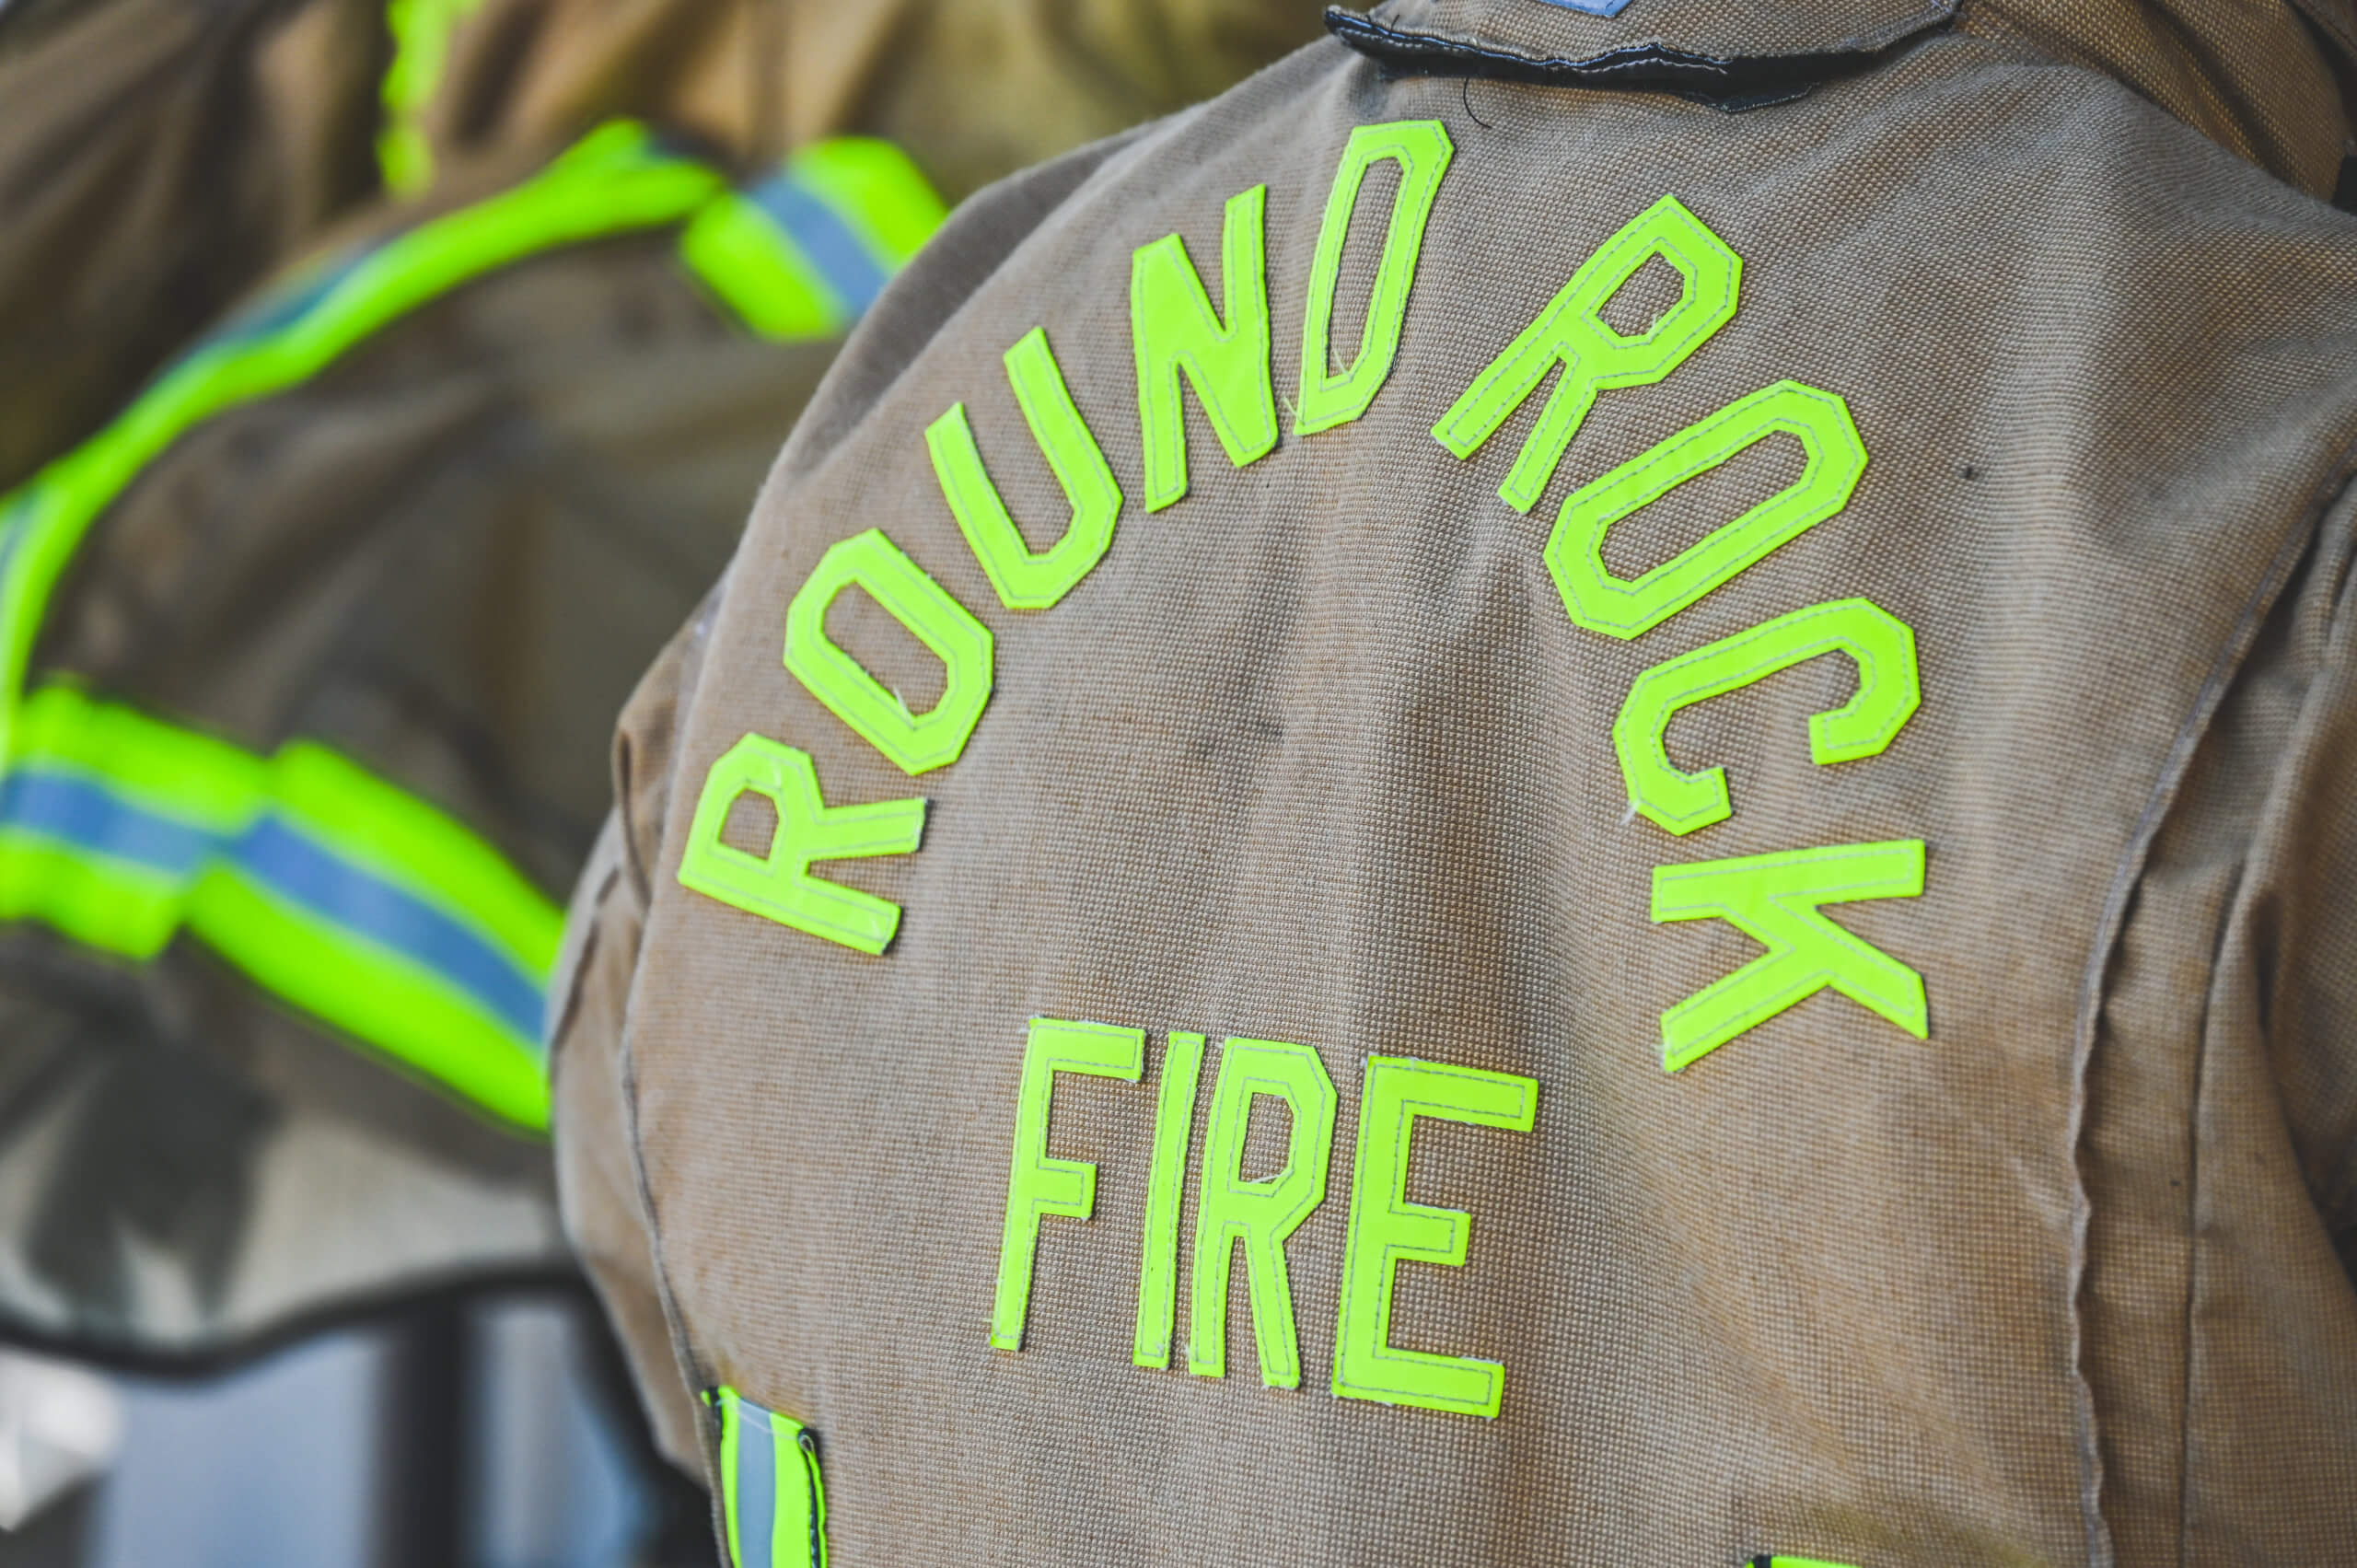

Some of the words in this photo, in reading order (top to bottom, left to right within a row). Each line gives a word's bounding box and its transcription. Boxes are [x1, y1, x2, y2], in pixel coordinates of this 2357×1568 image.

[679, 119, 1456, 956] ROUND
[1432, 194, 1930, 1074] ROCK
[990, 1017, 1539, 1419] FIRE
